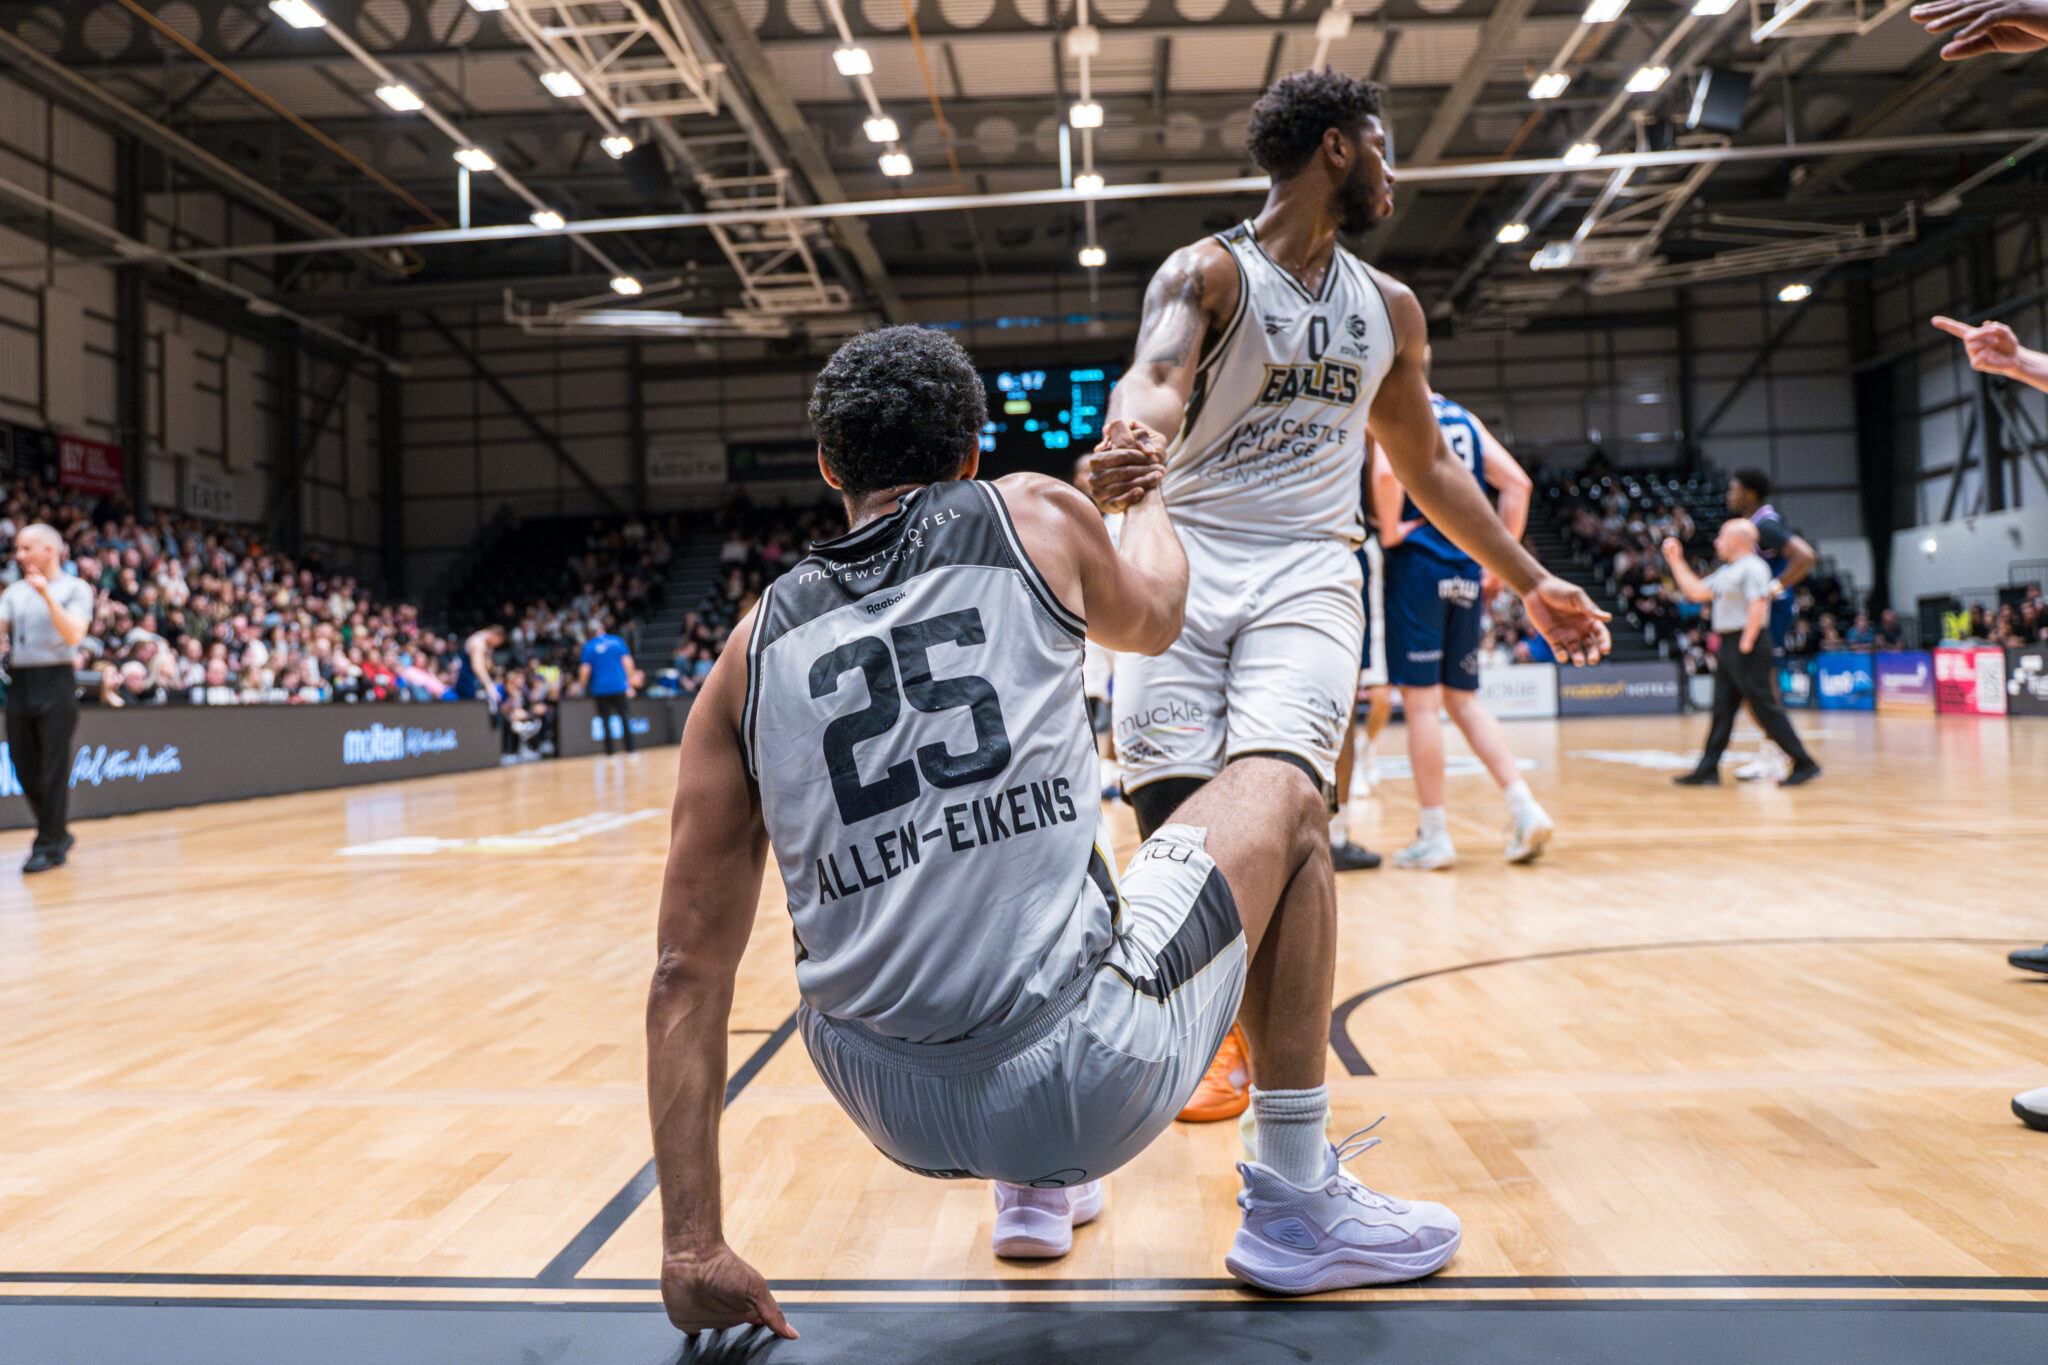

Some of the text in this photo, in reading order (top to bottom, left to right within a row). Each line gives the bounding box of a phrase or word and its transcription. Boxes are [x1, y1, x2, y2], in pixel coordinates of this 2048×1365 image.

[1309, 315, 1330, 362] 0
[1258, 360, 1360, 406] EALES
[1235, 440, 1318, 458] CLLEGE
[896, 508, 961, 547] OTEL
[866, 592, 907, 615] Reebok
[808, 607, 1012, 826] 25
[1118, 700, 1204, 735] muckle
[816, 777, 1077, 905] ALLEN-EIKENS
